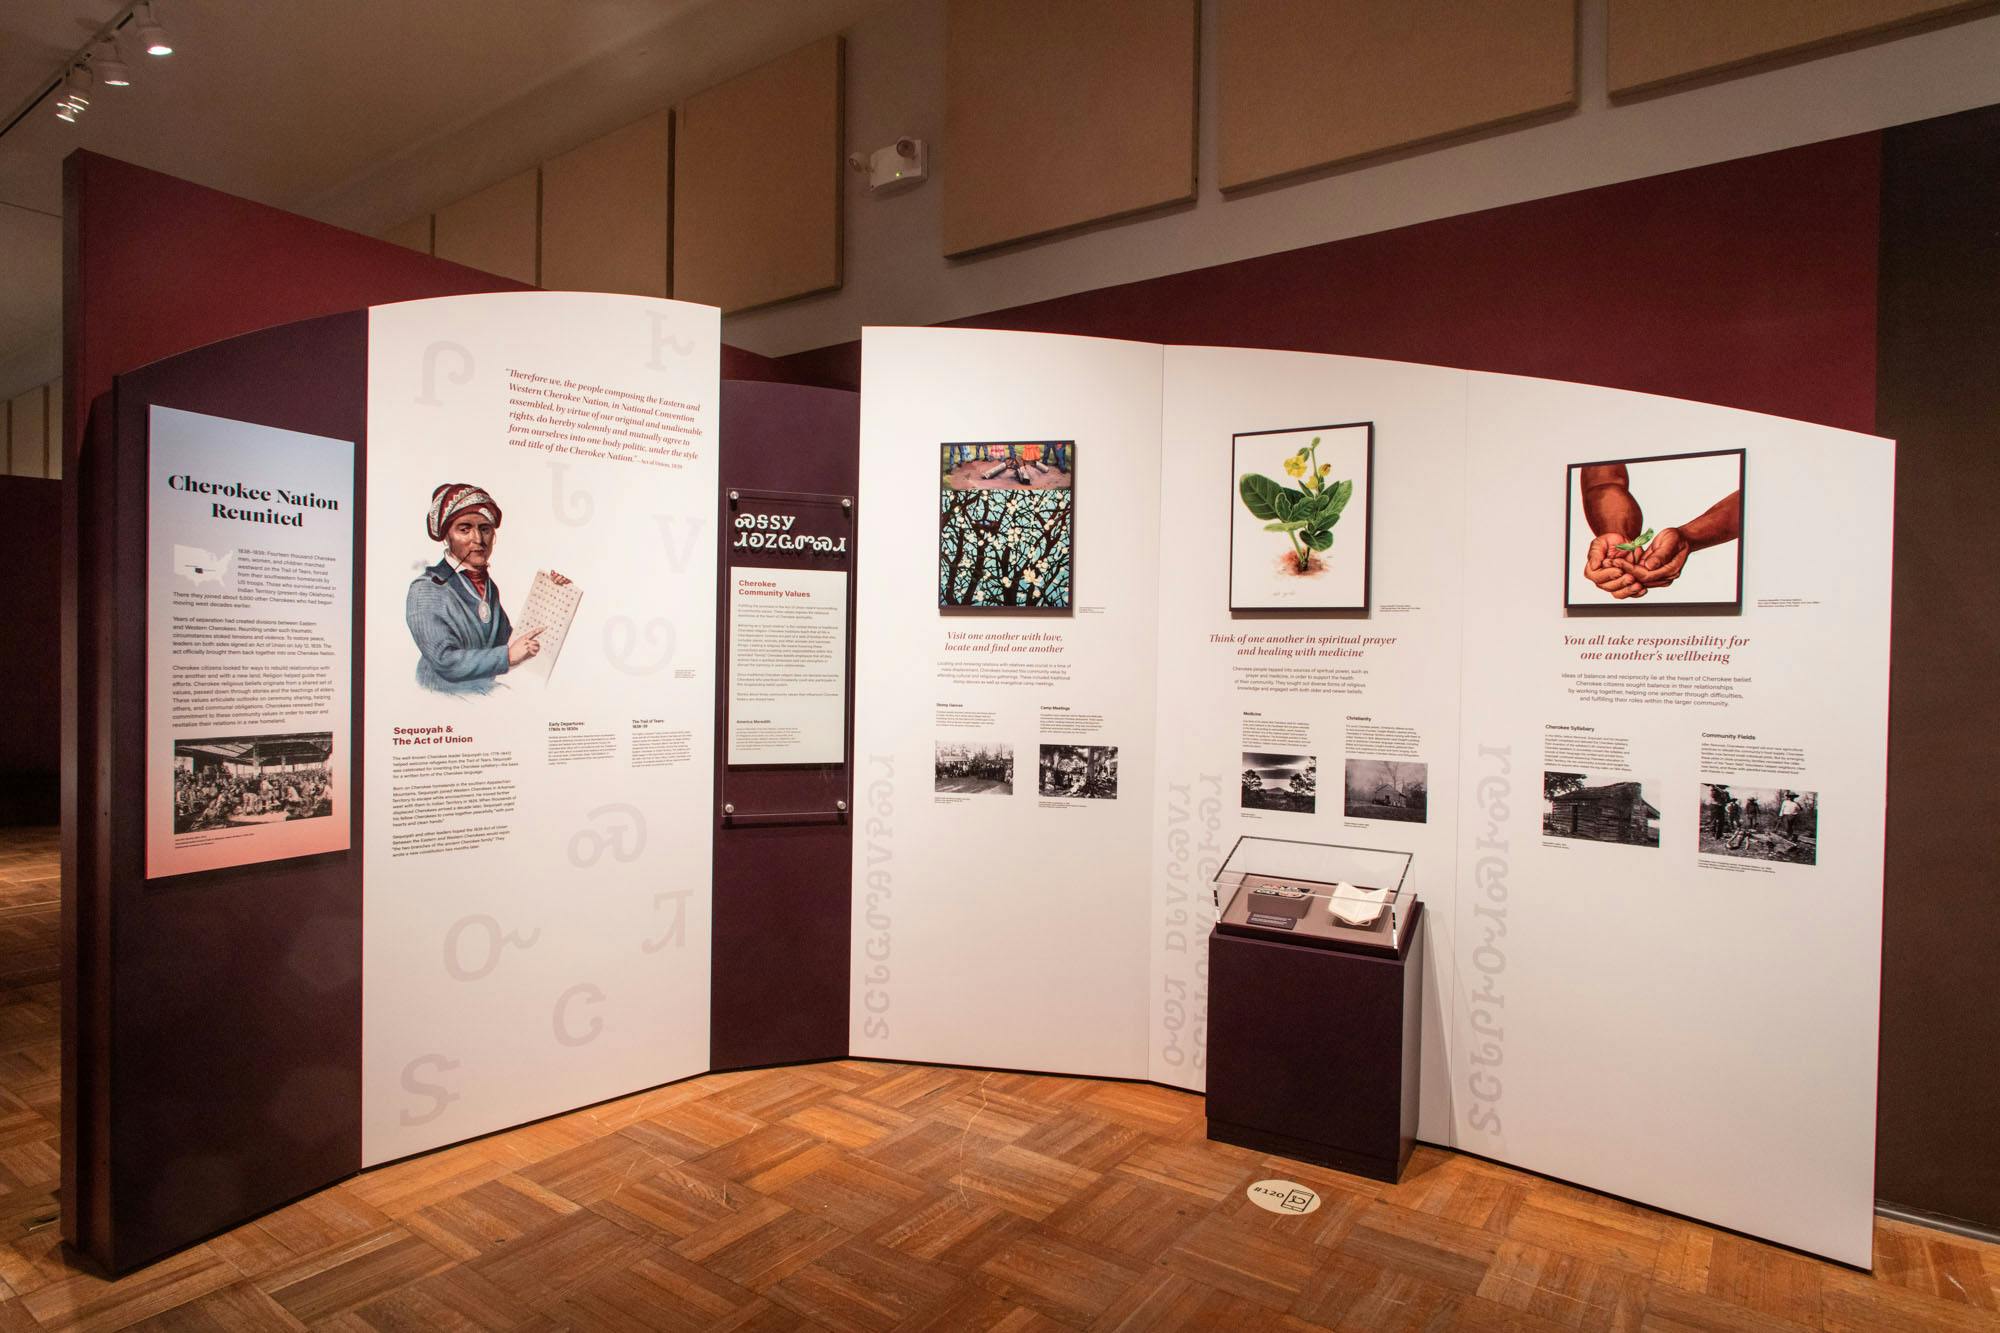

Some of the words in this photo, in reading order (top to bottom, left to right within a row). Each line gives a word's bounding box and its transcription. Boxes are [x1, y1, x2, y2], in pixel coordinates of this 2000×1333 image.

[508, 383, 541, 395] Western
[543, 390, 581, 402] Cherokee
[583, 396, 610, 408] Nation,
[622, 403, 654, 415] National
[655, 410, 695, 422] Convention
[564, 380, 577, 388] the
[577, 384, 604, 394] people
[604, 389, 645, 403] composing
[646, 395, 658, 403] the
[659, 397, 685, 408] Eastern
[686, 404, 701, 412] and
[555, 404, 566, 414] by
[567, 408, 590, 417] virtue
[591, 411, 600, 420] of
[615, 417, 645, 426] original
[661, 424, 703, 435] unalienable
[549, 416, 577, 429] hereby
[577, 422, 612, 434] solemnly
[629, 432, 663, 443] mutually
[507, 424, 530, 434] form
[531, 429, 569, 439] ourselves
[569, 434, 586, 442] into
[602, 437, 621, 449] body
[648, 447, 670, 455] under
[683, 452, 699, 460] style
[528, 441, 544, 449] title
[545, 443, 555, 453] of
[555, 444, 569, 452] the
[569, 447, 606, 458] Cherokee
[168, 475, 271, 501] Cherokee
[275, 489, 339, 510] Nation
[211, 503, 303, 527] Reunited
[738, 580, 777, 588] Cherokee
[738, 588, 784, 598] Community
[785, 590, 811, 598] Values
[947, 632, 966, 640] Visit
[985, 632, 1021, 641] another
[1022, 633, 1041, 641] with
[1210, 634, 1235, 643] Think
[1237, 634, 1248, 645] of
[1266, 634, 1304, 644] another
[1306, 635, 1316, 644] in
[1317, 635, 1361, 646] spiritual
[1362, 637, 1397, 647] prayer
[1564, 635, 1585, 645] You
[1588, 635, 1605, 645] all
[1607, 635, 1634, 646] take
[1637, 635, 1726, 649] responsibility
[1726, 635, 1751, 649] for
[944, 643, 971, 651] locate
[972, 643, 990, 652] and
[991, 644, 1010, 653] find
[1028, 644, 1065, 653] another
[1237, 647, 1256, 656] and
[1257, 647, 1293, 658] healing
[1294, 647, 1316, 656] with
[1318, 648, 1364, 657] medicine
[1580, 652, 1603, 660] one
[1666, 650, 1731, 665] wellbeing
[393, 725, 443, 736] Sequoyah
[446, 725, 454, 734] &
[1702, 732, 1736, 741] Community
[393, 737, 412, 746] The
[413, 736, 431, 745] Act
[433, 736, 443, 745] of
[445, 735, 473, 744] Union
[1253, 1186, 1285, 1199] #120
